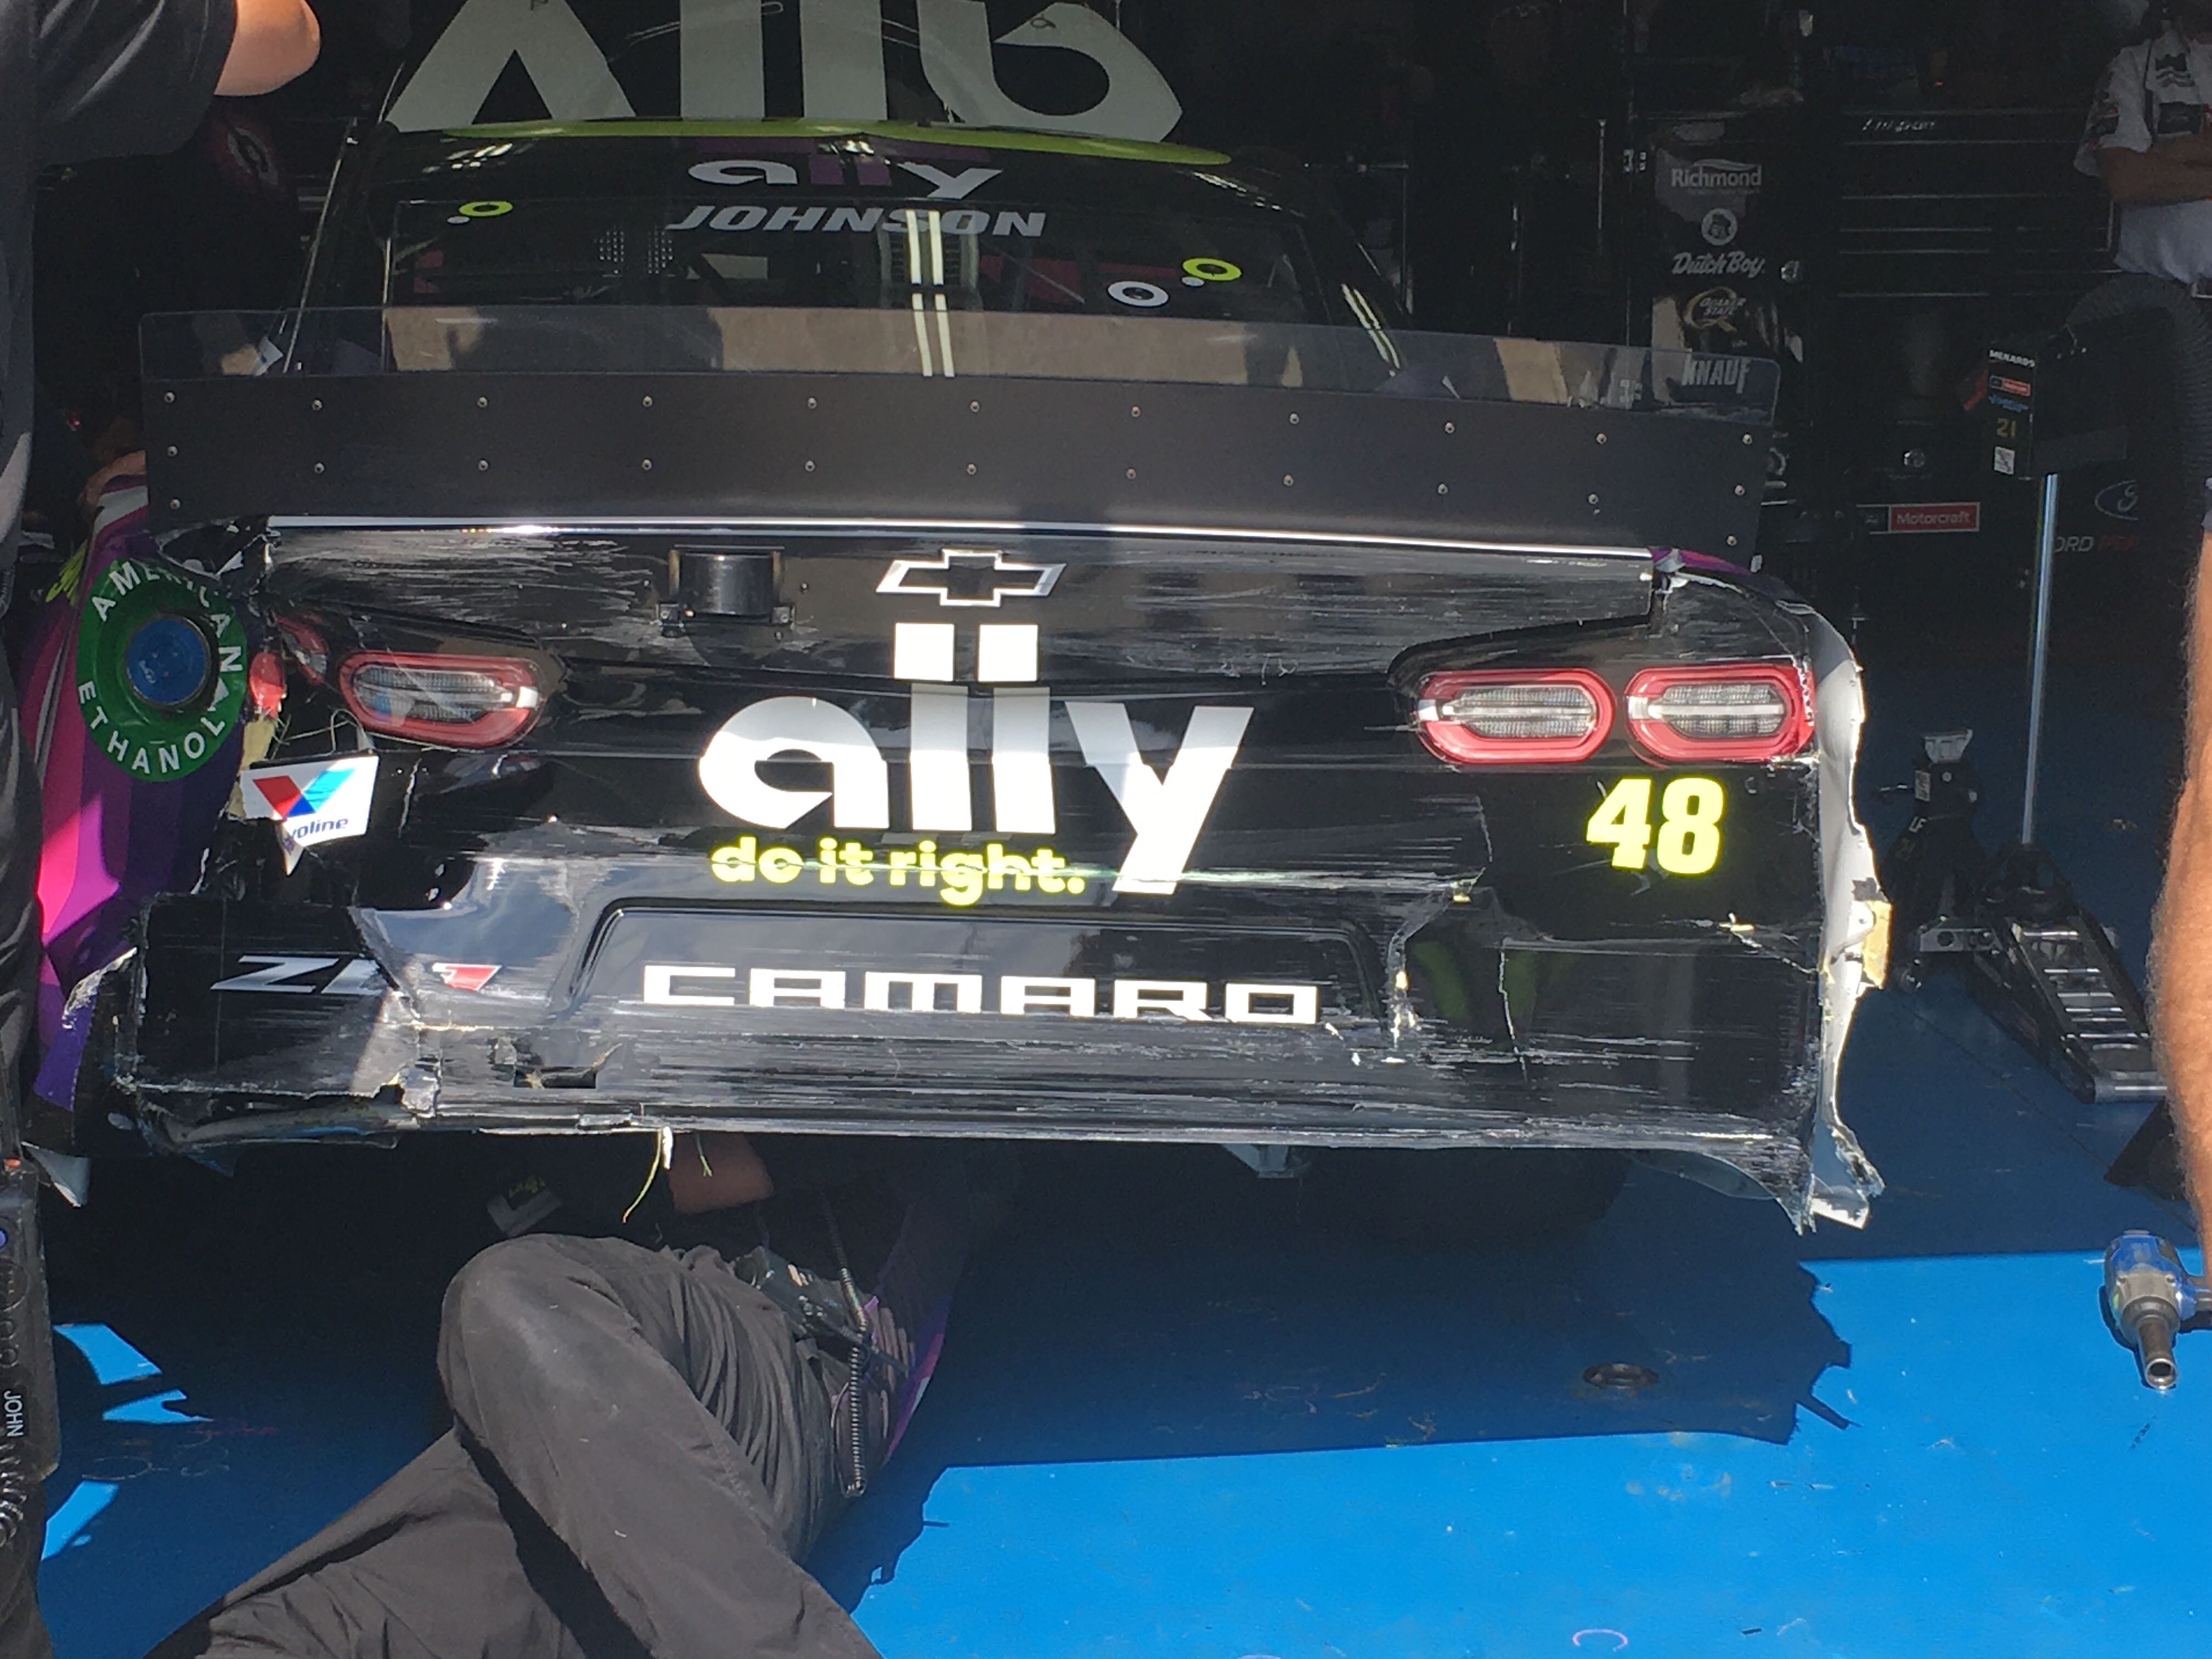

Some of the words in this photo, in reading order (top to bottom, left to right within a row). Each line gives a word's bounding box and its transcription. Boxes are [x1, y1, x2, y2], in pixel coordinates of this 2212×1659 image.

[688, 154, 1003, 200] ally
[1671, 165, 1762, 188] Richmond
[664, 205, 1047, 237] JOHNSON
[1672, 252, 1728, 274] Dutch
[1726, 250, 1766, 279] Boy
[1681, 354, 1751, 394] KNAUF
[1996, 418, 2016, 437] 21
[1897, 511, 1970, 525] Motorcraft
[2053, 535, 2094, 553] ORD
[78, 680, 226, 774] ETHANOL
[699, 623, 1254, 895] ally
[1585, 777, 1724, 874] 48
[711, 836, 804, 883] do
[819, 837, 873, 887] it
[889, 839, 1086, 907] right.
[642, 965, 1318, 1024] CAMARO
[3, 1390, 24, 1437] JOHN
